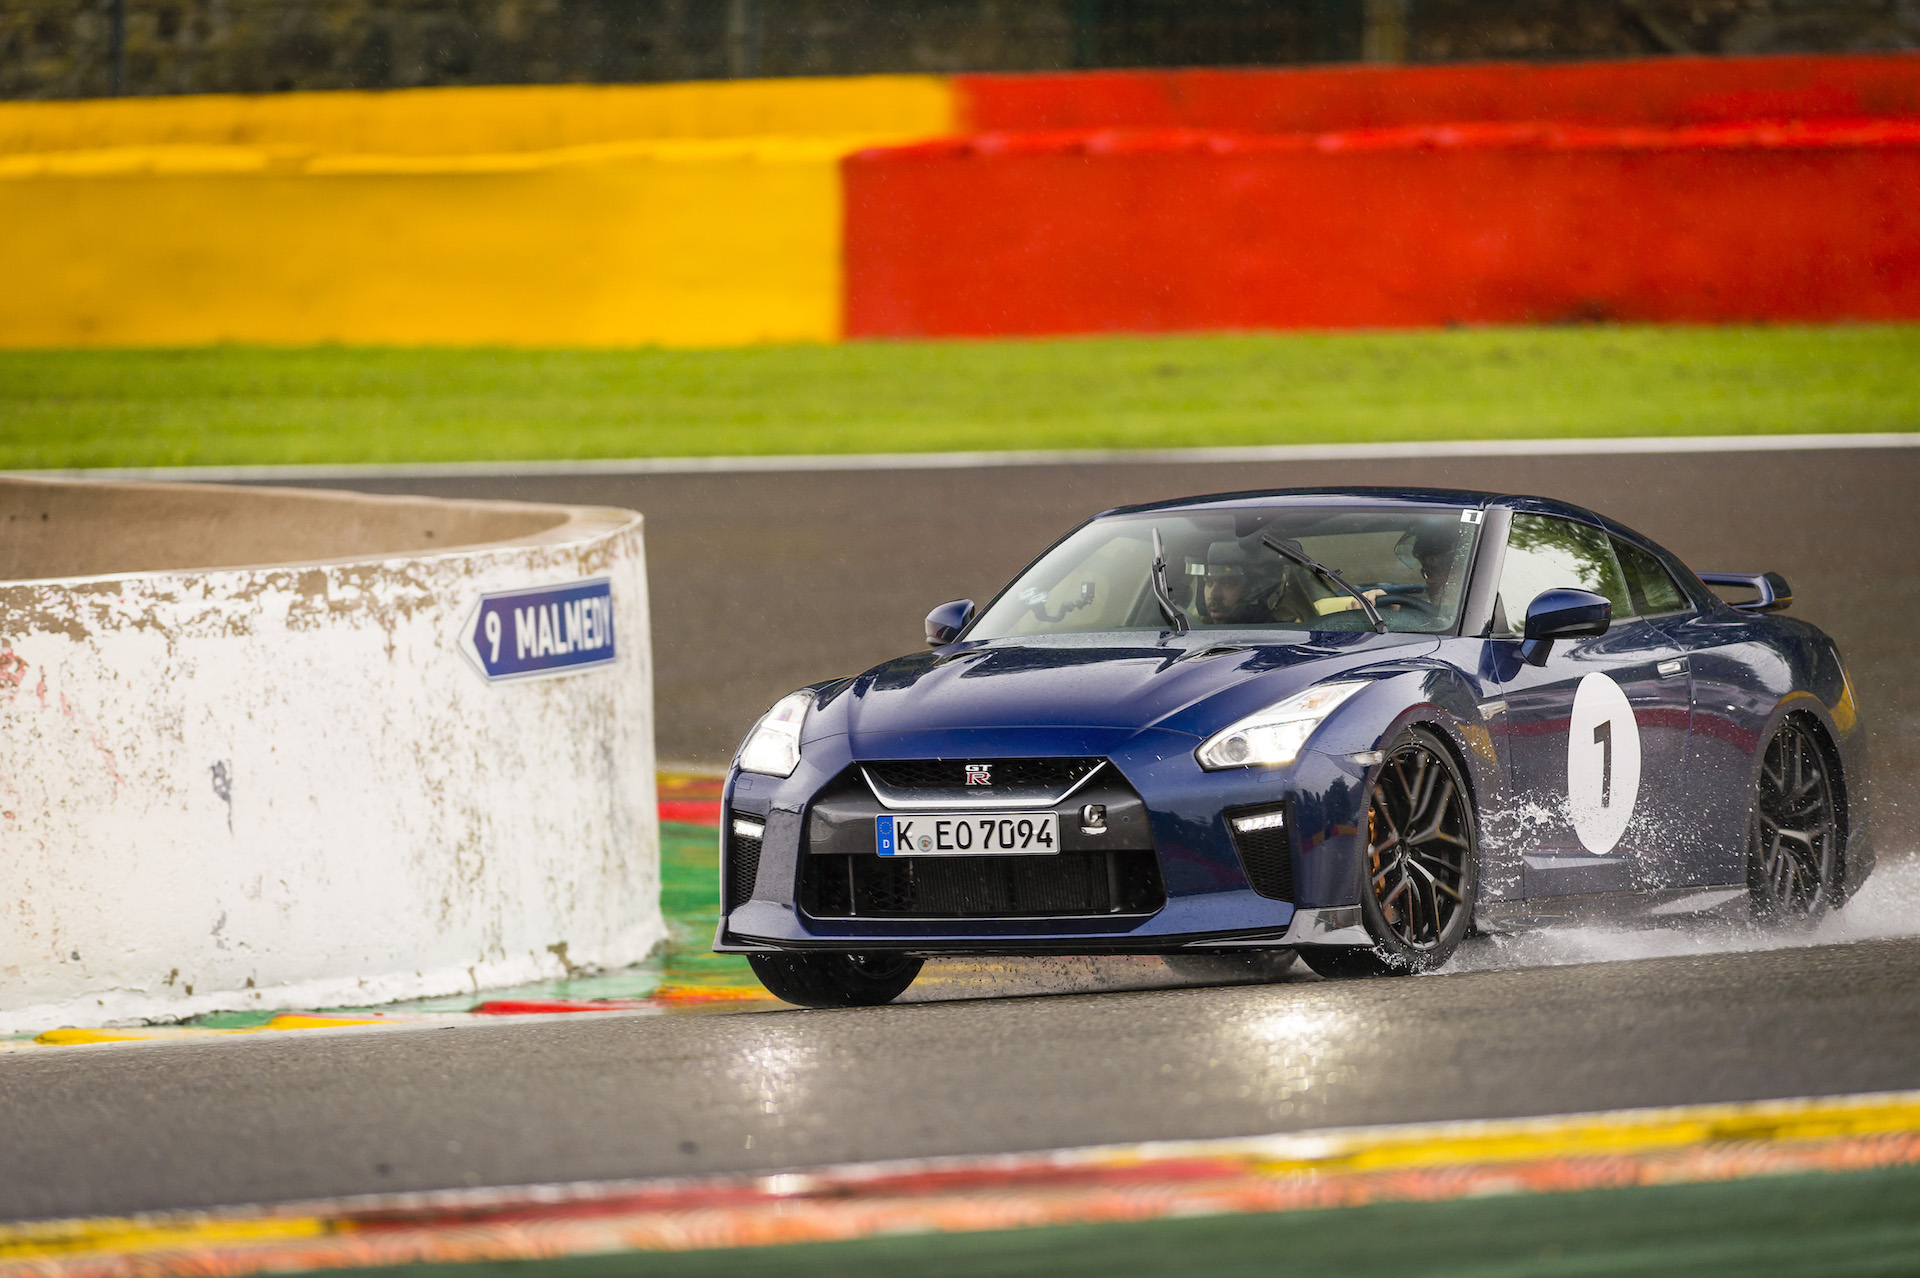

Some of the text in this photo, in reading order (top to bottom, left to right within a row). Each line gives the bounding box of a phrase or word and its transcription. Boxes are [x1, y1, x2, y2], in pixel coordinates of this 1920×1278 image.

[485, 595, 612, 663] 9 MALMEDY
[1593, 719, 1612, 808] 1
[882, 839, 890, 849] D
[896, 821, 915, 850] K
